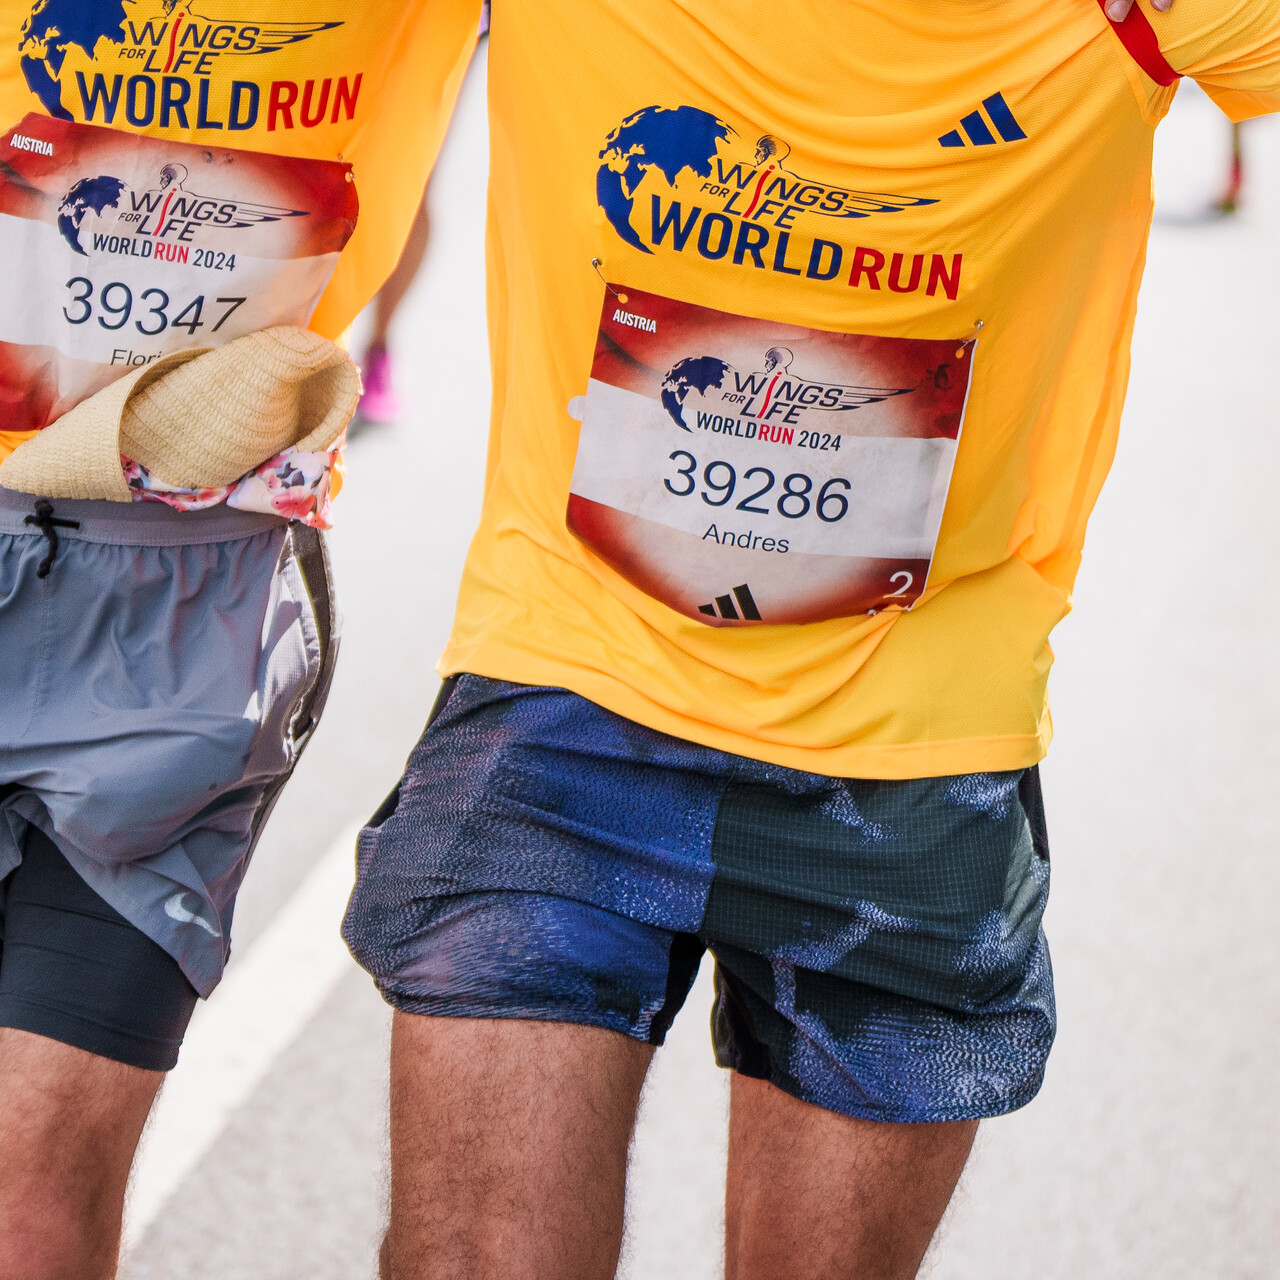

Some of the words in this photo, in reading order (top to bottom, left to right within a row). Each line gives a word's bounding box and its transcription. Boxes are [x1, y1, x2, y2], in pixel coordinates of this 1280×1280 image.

[118, 47, 147, 60] FOR
[10, 132, 54, 157] AUSTRIA
[699, 181, 729, 199] FOR
[117, 211, 142, 224] FOR
[192, 248, 237, 272] 2024
[62, 275, 248, 337] 39347
[612, 308, 658, 335] AUSTRIA
[721, 391, 747, 405] FOR
[796, 429, 843, 453] 2024
[662, 449, 853, 524] 39286
[701, 523, 791, 554] Andres
[881, 570, 914, 600] 2
